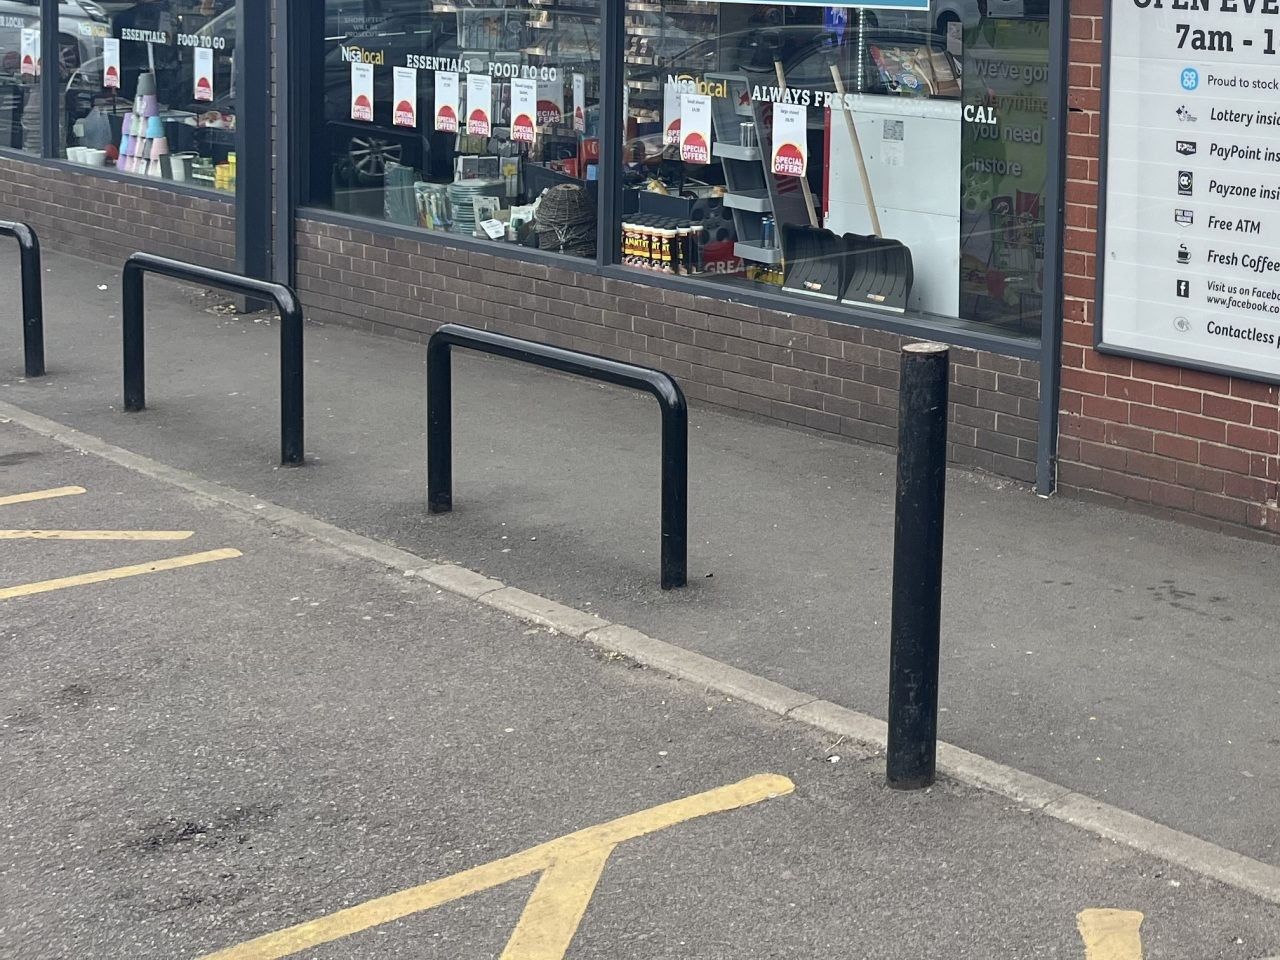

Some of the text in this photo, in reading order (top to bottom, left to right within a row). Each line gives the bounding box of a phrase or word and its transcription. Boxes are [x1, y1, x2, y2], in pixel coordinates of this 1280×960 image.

[6, 16, 25, 28] LOCAL
[121, 28, 226, 50] ESSENTIALS FOOD TO GO
[1175, 23, 1234, 52] 7am
[406, 54, 471, 74] ESSENTIALS
[488, 62, 519, 78] FOOD
[521, 65, 538, 79] TO
[540, 67, 557, 82] GO
[975, 60, 1020, 78] We've
[1207, 74, 1237, 87] Proud
[1239, 78, 1250, 88] to
[1252, 78, 1279, 90] stock
[751, 85, 811, 106] ALWAYS
[537, 109, 560, 117] ECIAL
[537, 115, 560, 124] FERS
[1210, 108, 1253, 127] Lottery
[513, 125, 533, 134] SPECIAL
[513, 131, 534, 141] OFFERS
[972, 125, 1042, 144] you need
[682, 151, 708, 162] OFFERS
[683, 144, 707, 154] SPECIAL
[1210, 143, 1262, 161] PayPoint
[775, 155, 803, 166] SPECIAL
[775, 163, 802, 174] OFFERS
[971, 155, 1023, 177] instore
[1209, 180, 1257, 198] Payzone
[1208, 216, 1233, 231] Free
[1235, 219, 1261, 235] ATM
[1207, 249, 1280, 273] Fresh Coffee
[1207, 281, 1226, 293] Visit
[1227, 285, 1237, 294] us
[1239, 287, 1250, 296] on
[1207, 321, 1275, 344] Contactless
